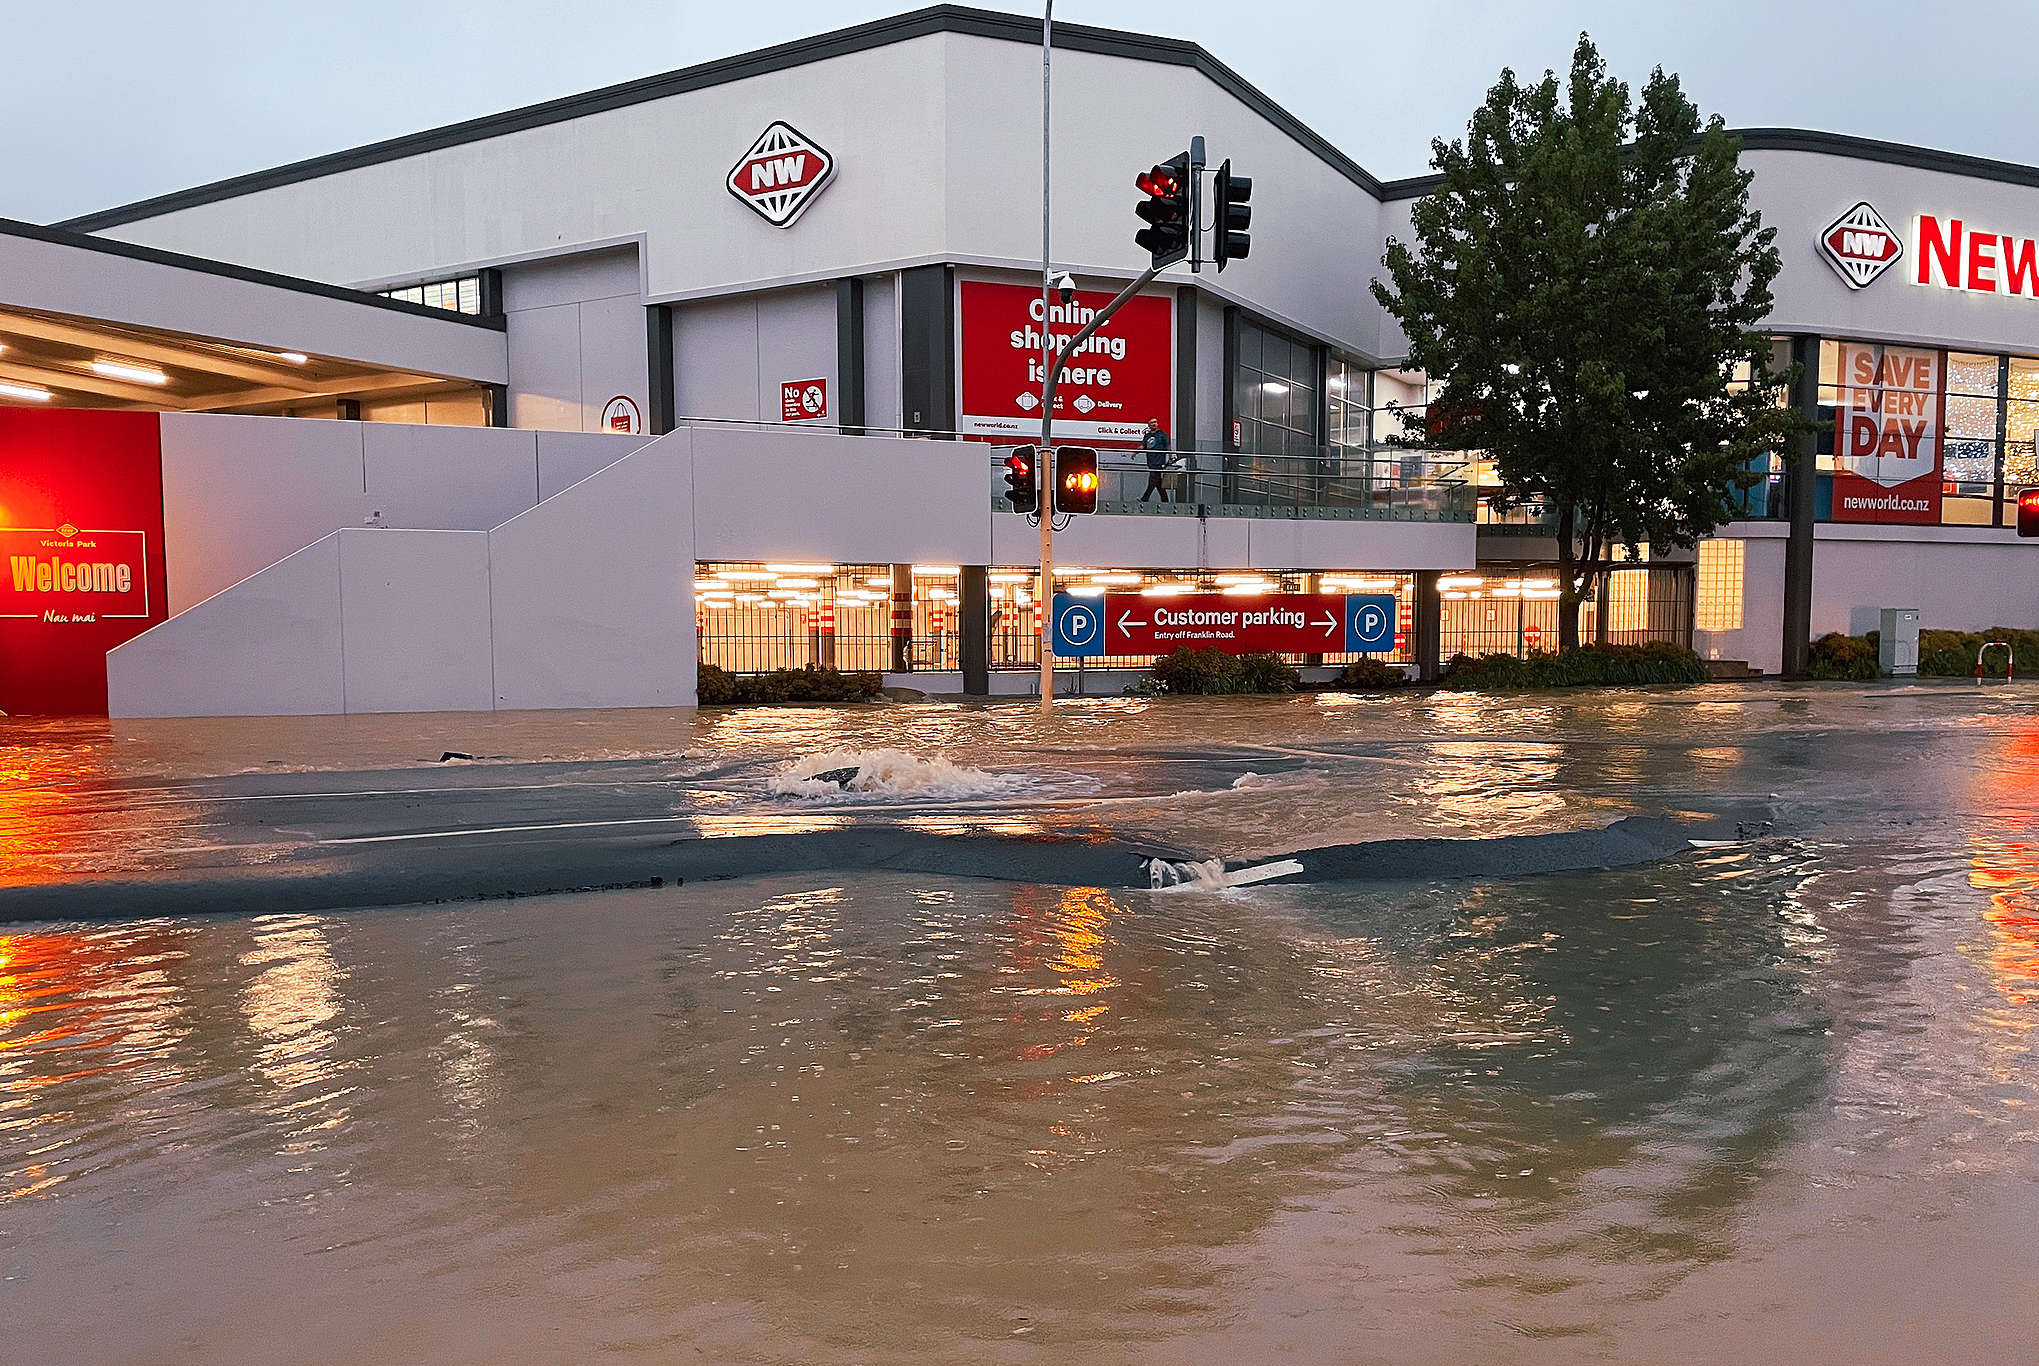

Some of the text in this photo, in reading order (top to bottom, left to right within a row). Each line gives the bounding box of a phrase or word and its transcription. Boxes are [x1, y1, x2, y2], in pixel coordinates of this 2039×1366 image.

[751, 153, 806, 190] NW
[1842, 230, 1887, 258] NW
[1911, 214, 2039, 300] NEW
[1010, 324, 1126, 361] shopping
[1028, 357, 1045, 383] is
[1853, 351, 1931, 389] SAVE
[784, 386, 800, 399] No
[1852, 388, 1929, 417] EVERY
[1097, 400, 1123, 410] Delivery
[1097, 426, 1141, 436] Click & Collect
[1851, 415, 1929, 460] DAY
[1843, 494, 1930, 512] newworld.co.nz
[40, 539, 97, 548] Victoria Park
[10, 556, 132, 593] Welcome
[43, 609, 96, 623] Nau mai
[1072, 615, 1088, 636] P
[1153, 606, 1305, 629] Customer parking
[1365, 613, 1379, 633] P
[1154, 630, 1236, 641] Entry off Franklin Road.
